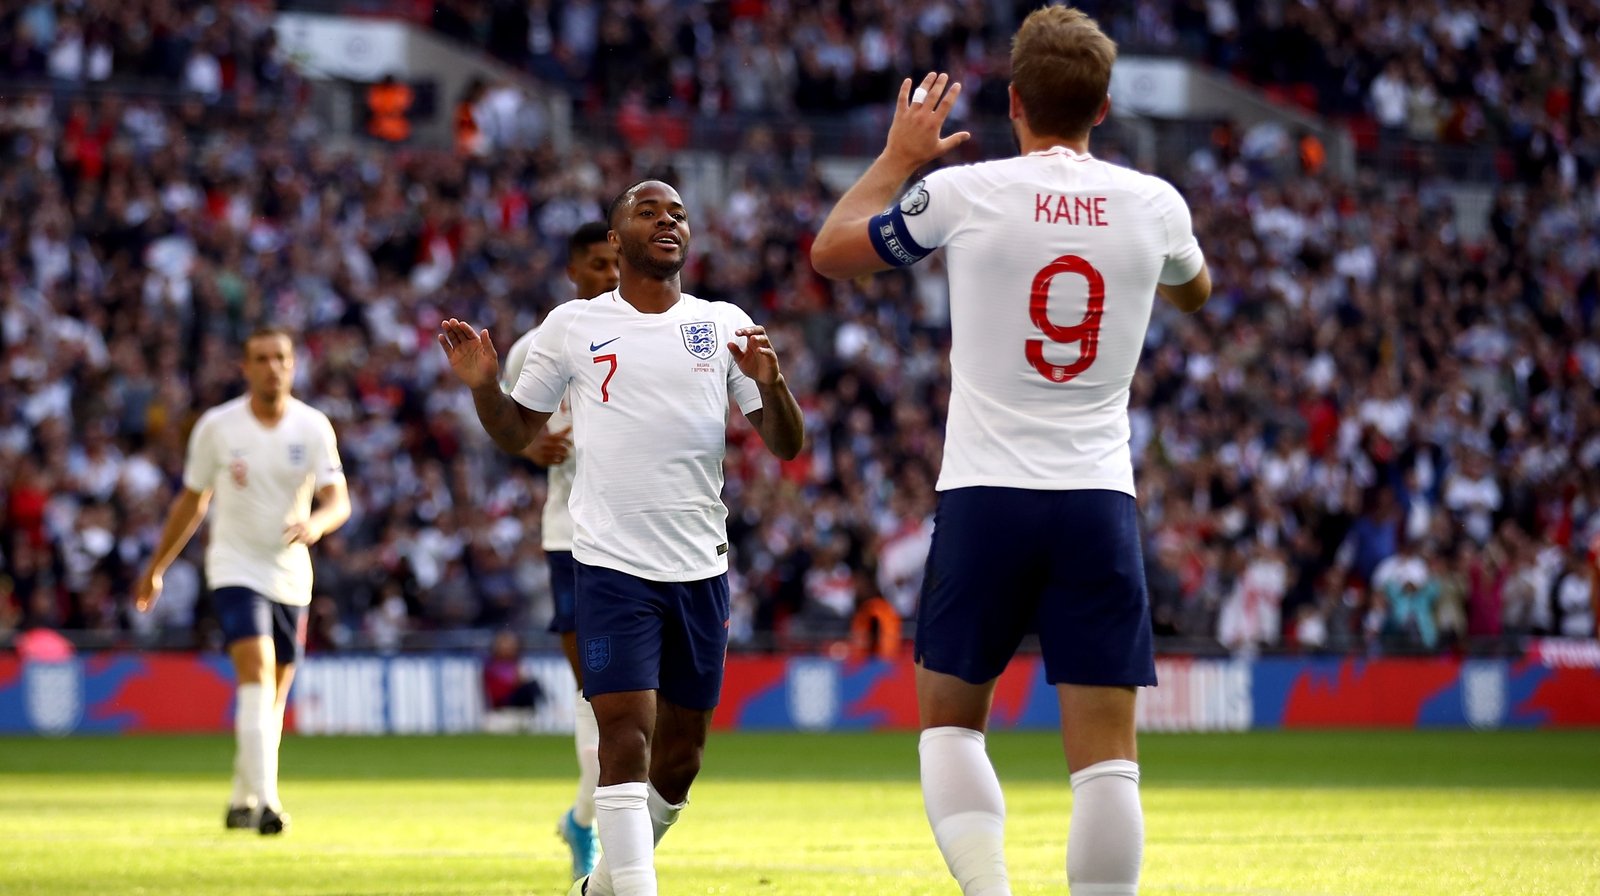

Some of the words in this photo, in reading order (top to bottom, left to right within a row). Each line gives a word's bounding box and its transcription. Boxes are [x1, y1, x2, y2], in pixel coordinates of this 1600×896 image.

[1035, 193, 1108, 226] KANE
[1025, 255, 1105, 383] 9
[593, 354, 617, 402] 7
